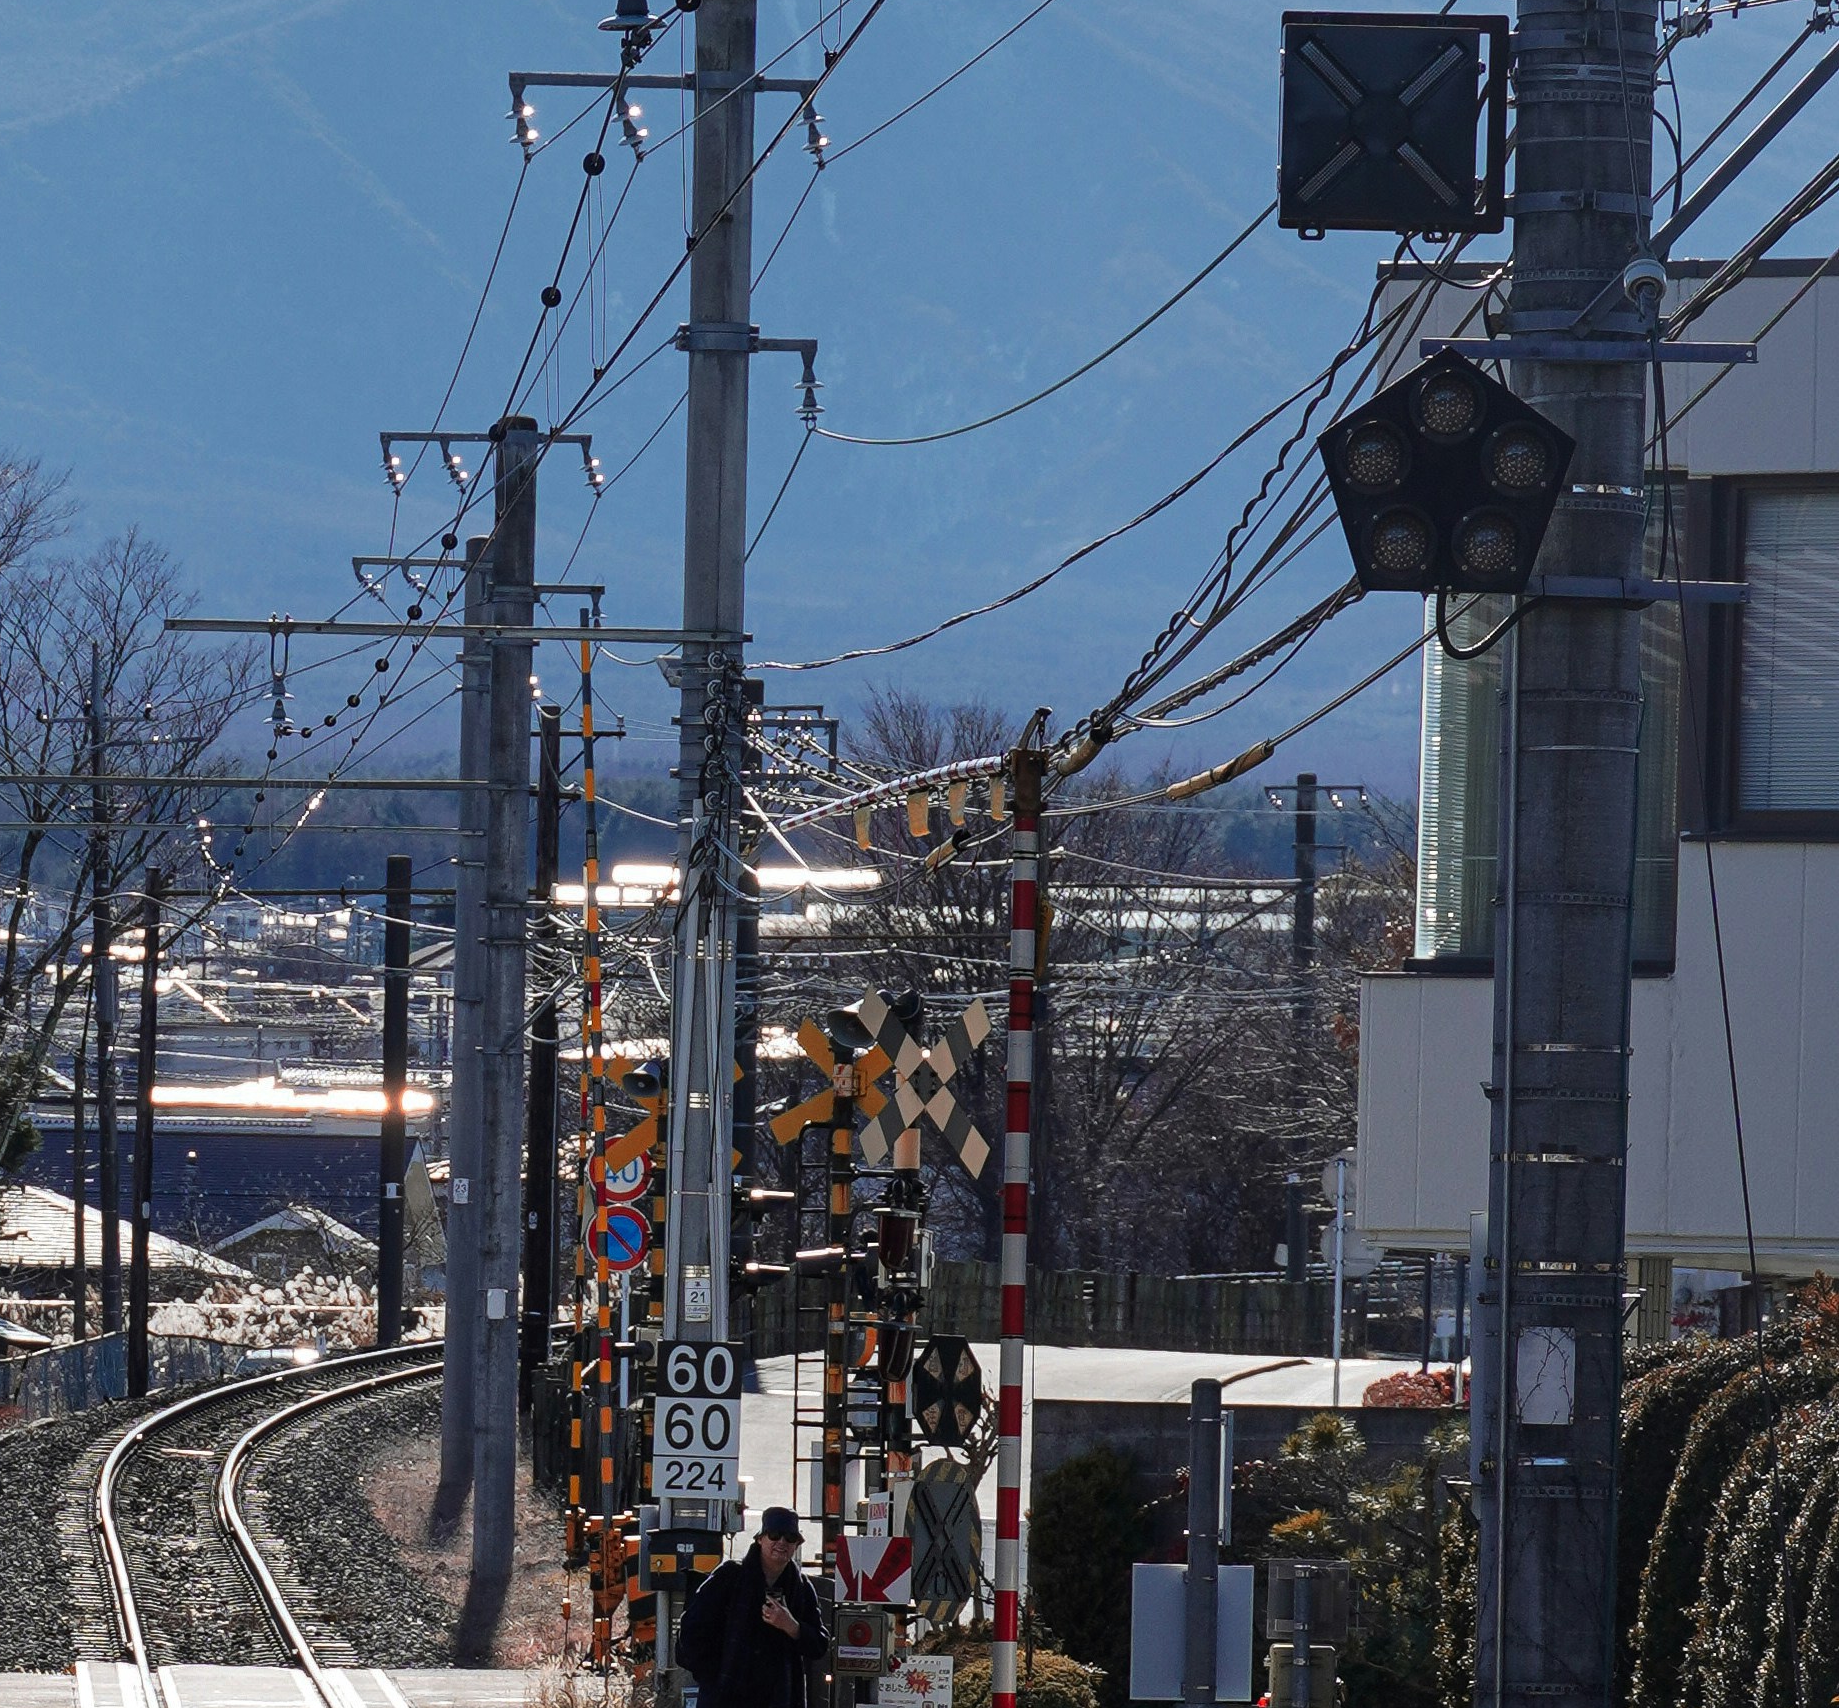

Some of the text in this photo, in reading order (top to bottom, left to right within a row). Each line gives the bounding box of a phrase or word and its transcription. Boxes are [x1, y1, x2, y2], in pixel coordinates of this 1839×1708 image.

[455, 1183, 467, 1194] 23
[690, 1291, 706, 1304] 21
[667, 1344, 734, 1395] 60
[665, 1402, 731, 1452] 60
[665, 1460, 726, 1492] 224
